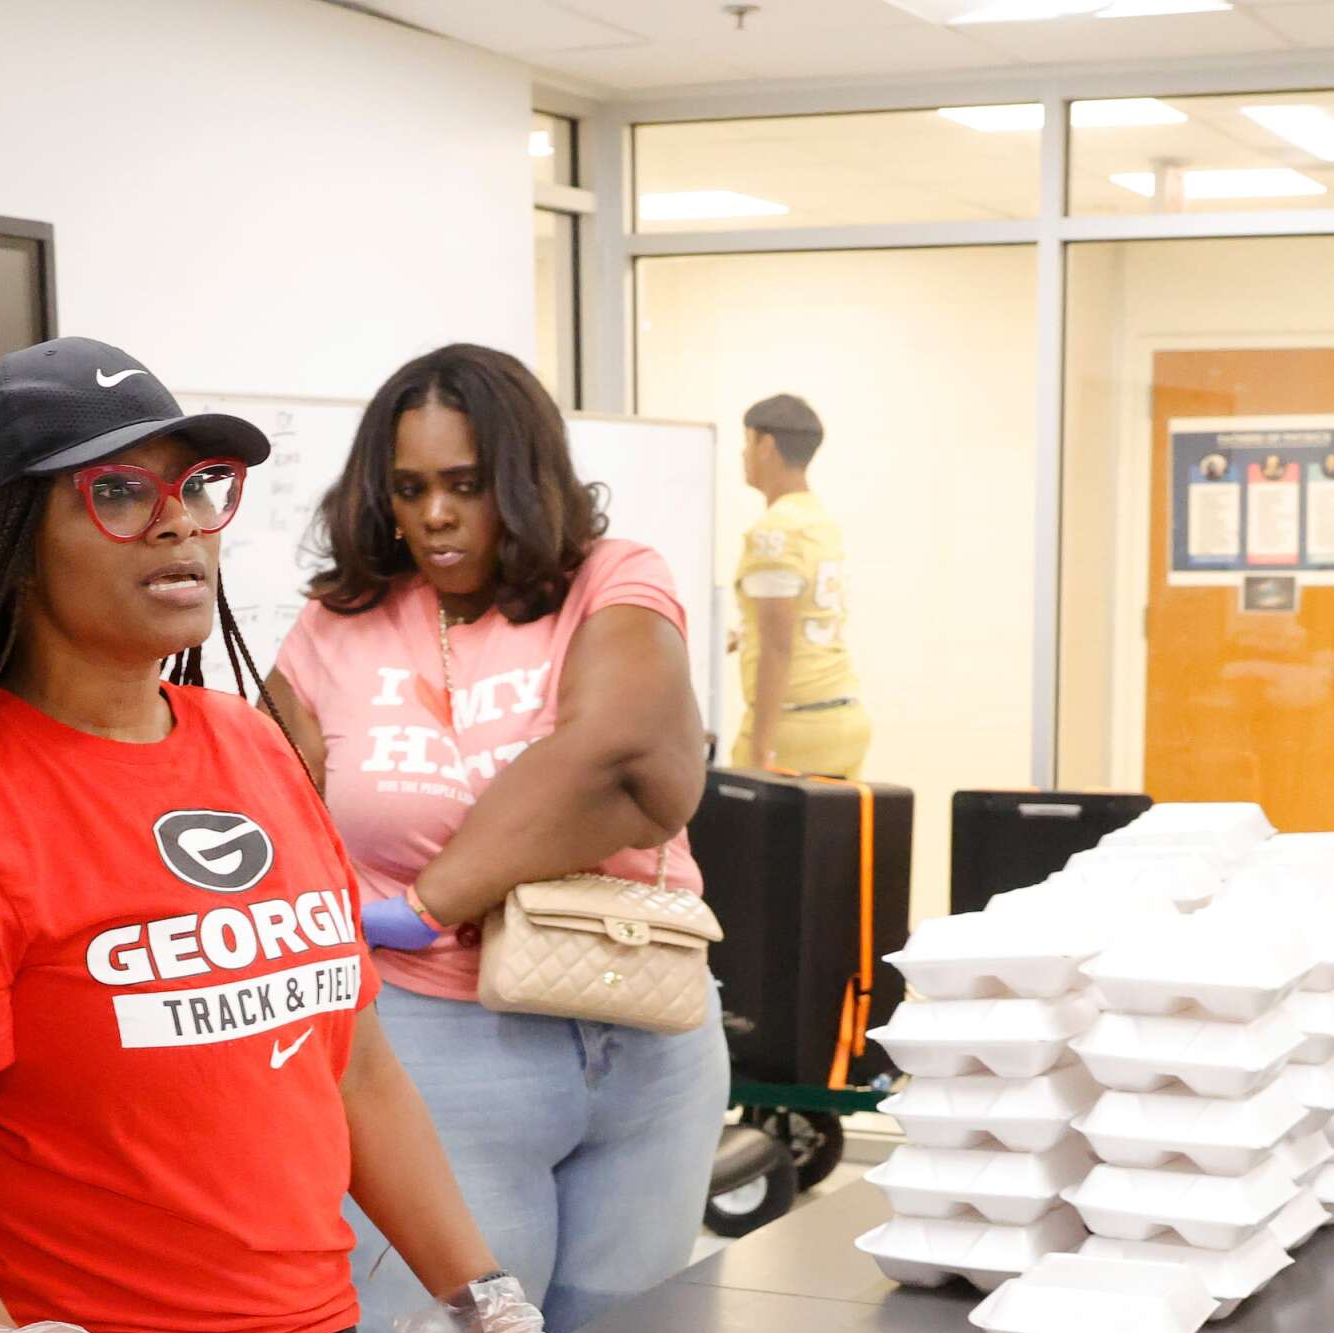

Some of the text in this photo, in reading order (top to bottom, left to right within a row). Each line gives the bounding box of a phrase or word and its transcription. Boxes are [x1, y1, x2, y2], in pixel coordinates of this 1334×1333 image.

[371, 667, 411, 705] I
[152, 808, 275, 893] G
[163, 963, 357, 1037] TRACK & FIEL
